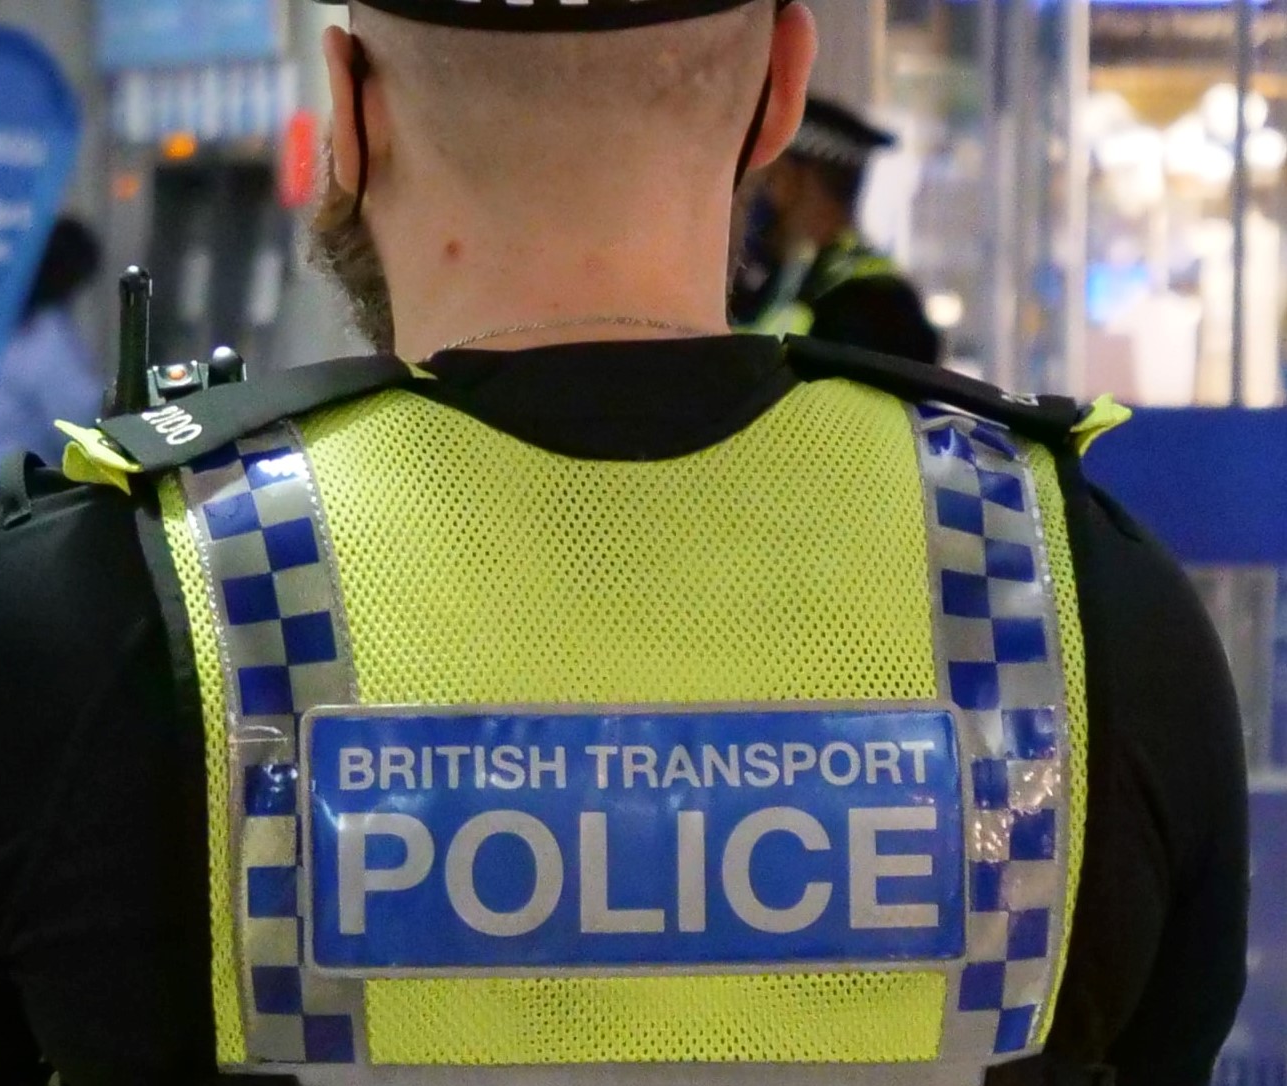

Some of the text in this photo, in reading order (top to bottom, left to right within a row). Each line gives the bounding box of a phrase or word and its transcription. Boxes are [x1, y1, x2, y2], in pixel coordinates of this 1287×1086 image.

[338, 740, 935, 791] BRITISH TRANSPORT
[336, 806, 940, 938] POLICE
